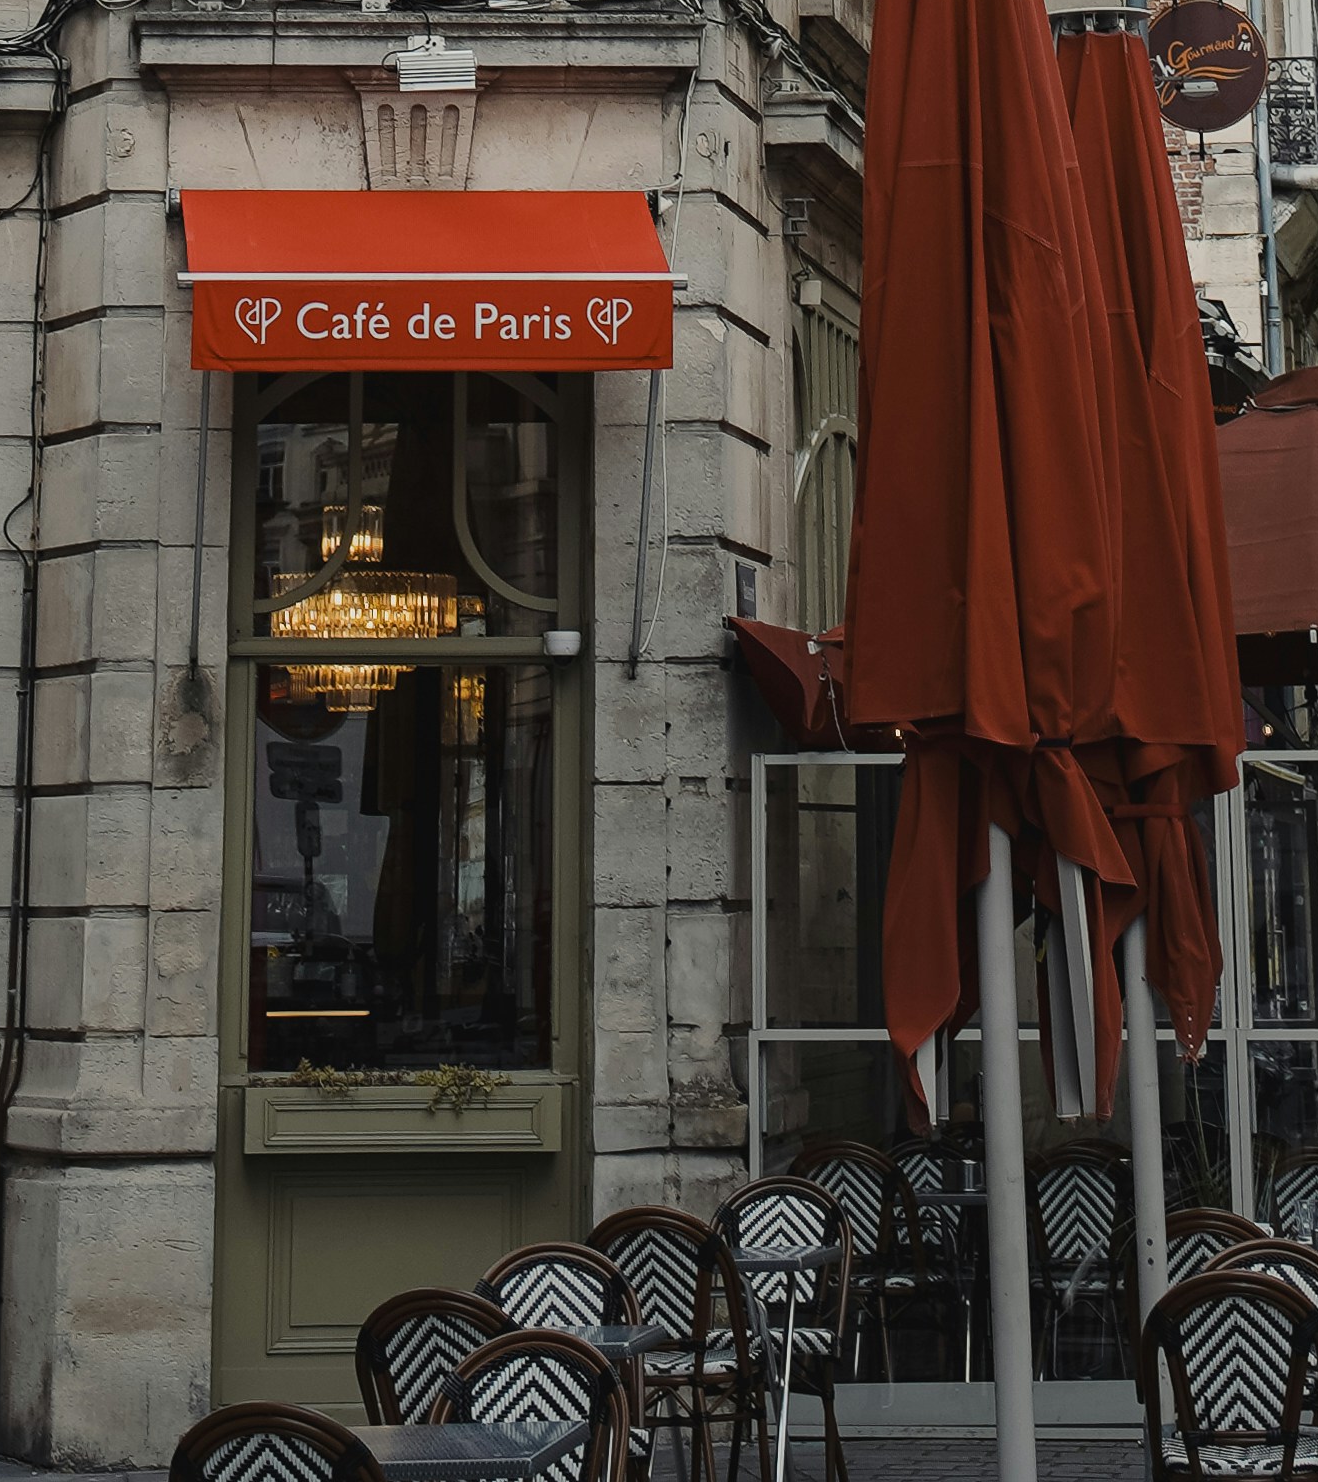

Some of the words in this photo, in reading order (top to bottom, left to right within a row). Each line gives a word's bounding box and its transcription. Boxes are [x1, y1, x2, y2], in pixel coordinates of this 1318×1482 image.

[296, 302, 390, 340] Café
[407, 303, 456, 340] de
[476, 303, 572, 340] Paris
